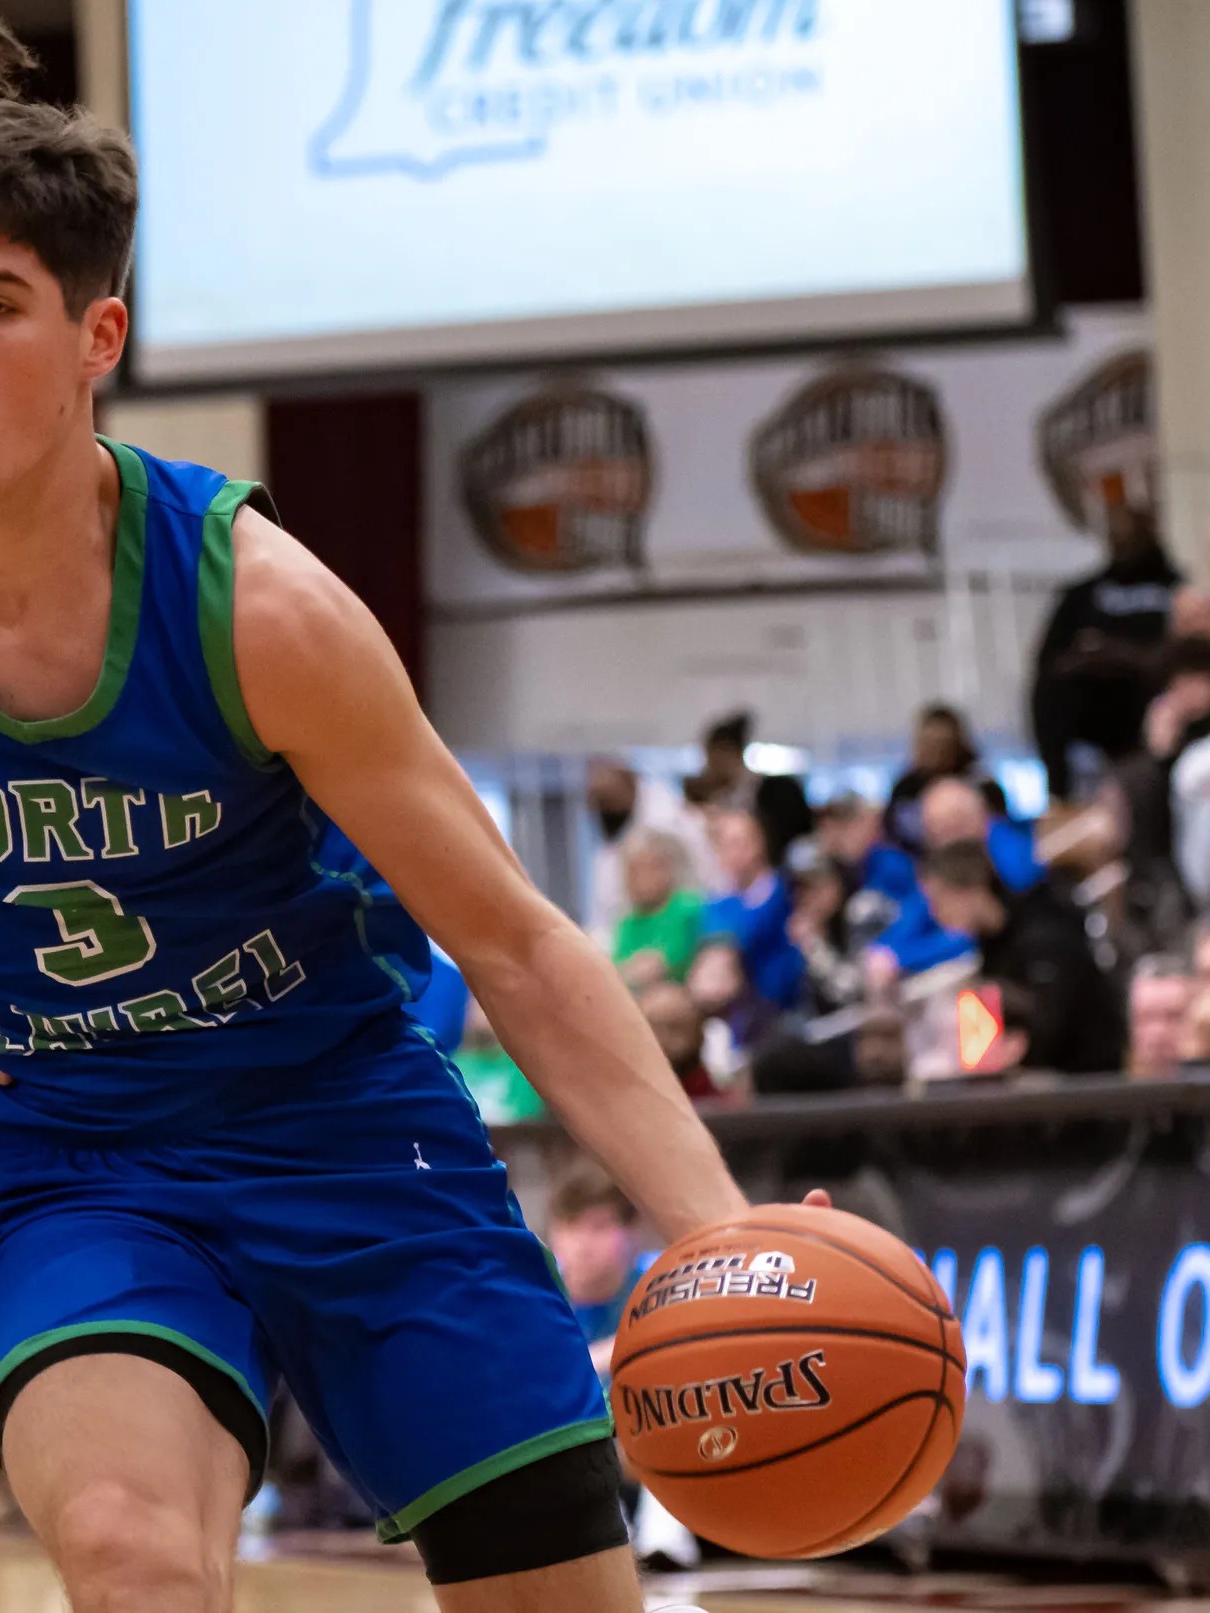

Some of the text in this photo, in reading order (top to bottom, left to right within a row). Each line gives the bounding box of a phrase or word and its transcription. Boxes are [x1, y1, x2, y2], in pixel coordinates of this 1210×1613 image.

[425, 63, 824, 134] CREDIT UNION
[2, 880, 157, 987] 3
[628, 1270, 818, 1328] PRECISION
[619, 1349, 831, 1436] SPALDING
